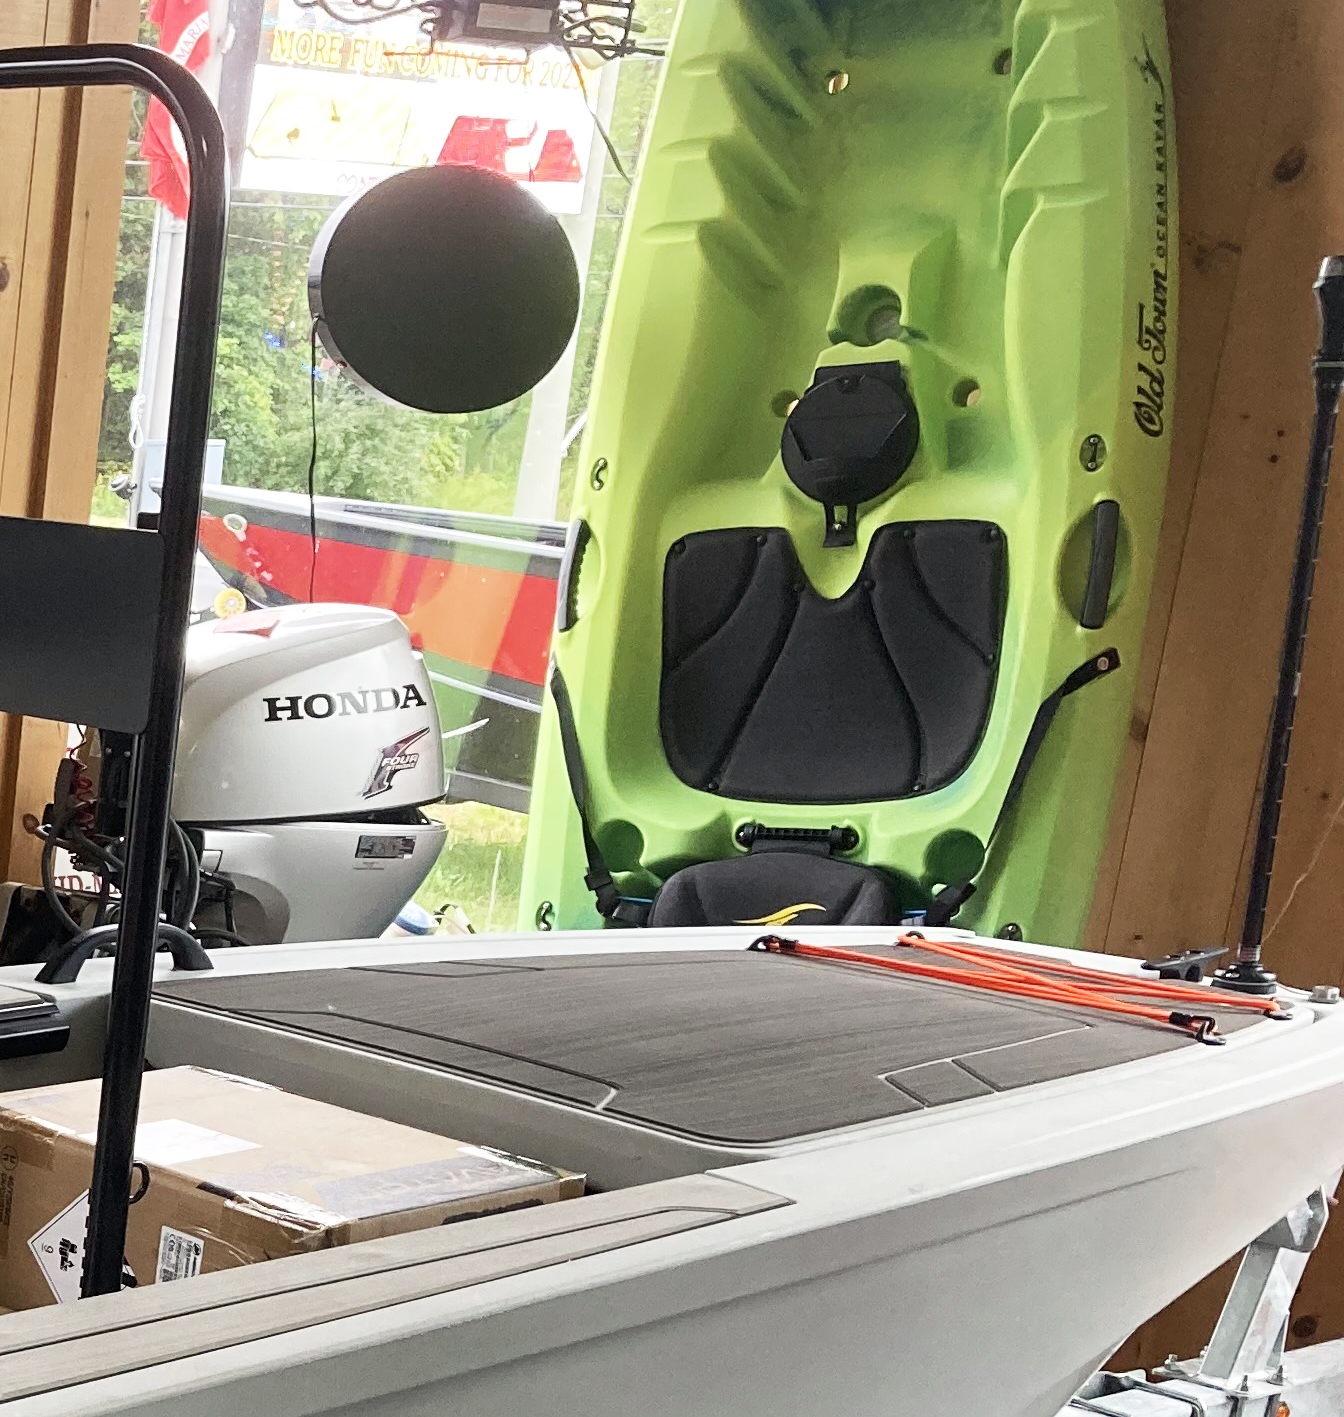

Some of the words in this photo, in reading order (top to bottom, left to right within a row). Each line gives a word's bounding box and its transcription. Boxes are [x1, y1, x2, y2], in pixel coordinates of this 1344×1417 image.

[272, 28, 343, 66] MORE
[350, 39, 395, 73] FUN
[494, 54, 534, 86] FOR
[1153, 101, 1167, 172] KAYAK
[1156, 183, 1167, 259] OCEAN
[1137, 269, 1168, 365] Town
[1133, 361, 1165, 438] Old
[263, 684, 426, 723] HONDA
[381, 753, 419, 768] FOUR
